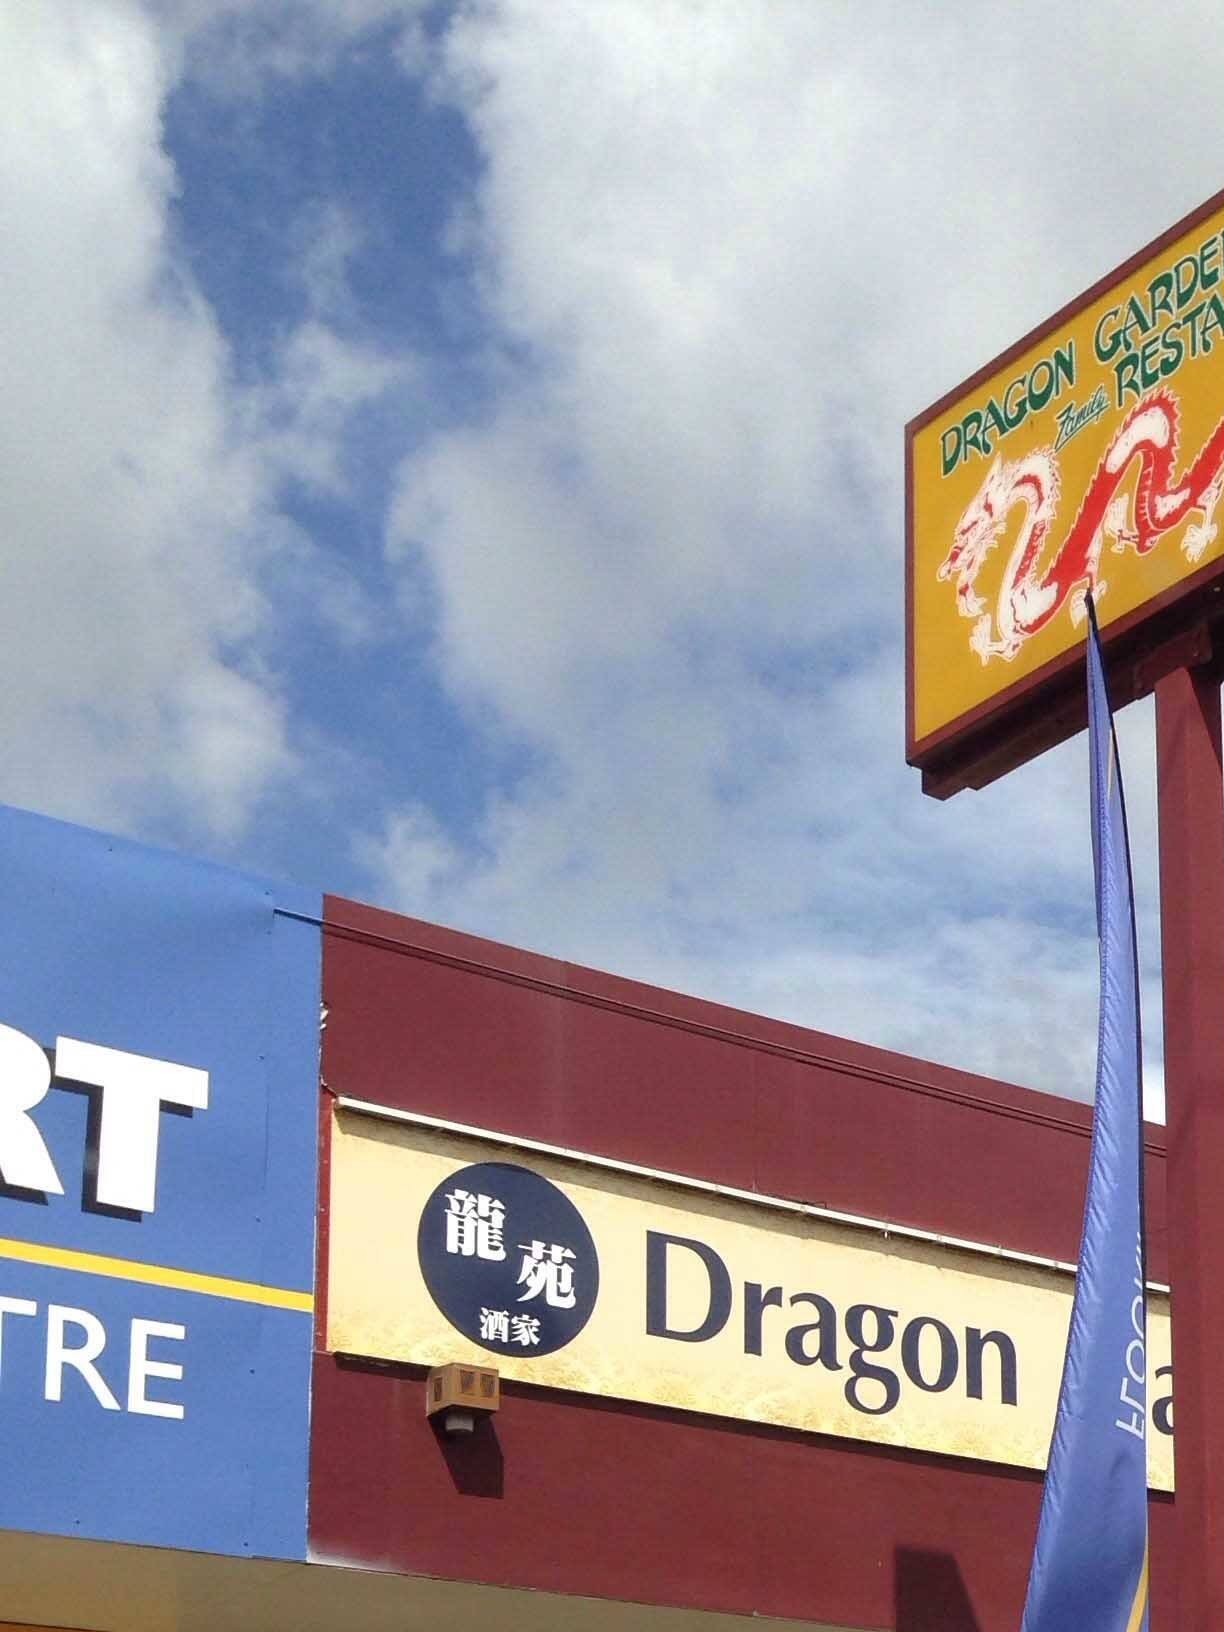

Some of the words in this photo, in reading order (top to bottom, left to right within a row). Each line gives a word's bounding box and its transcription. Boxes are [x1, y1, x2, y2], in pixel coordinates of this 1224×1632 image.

[941, 339, 1076, 477] DRAGON
[479, 1307, 541, 1346] 酒家
[645, 1229, 1018, 1416] Dragon
